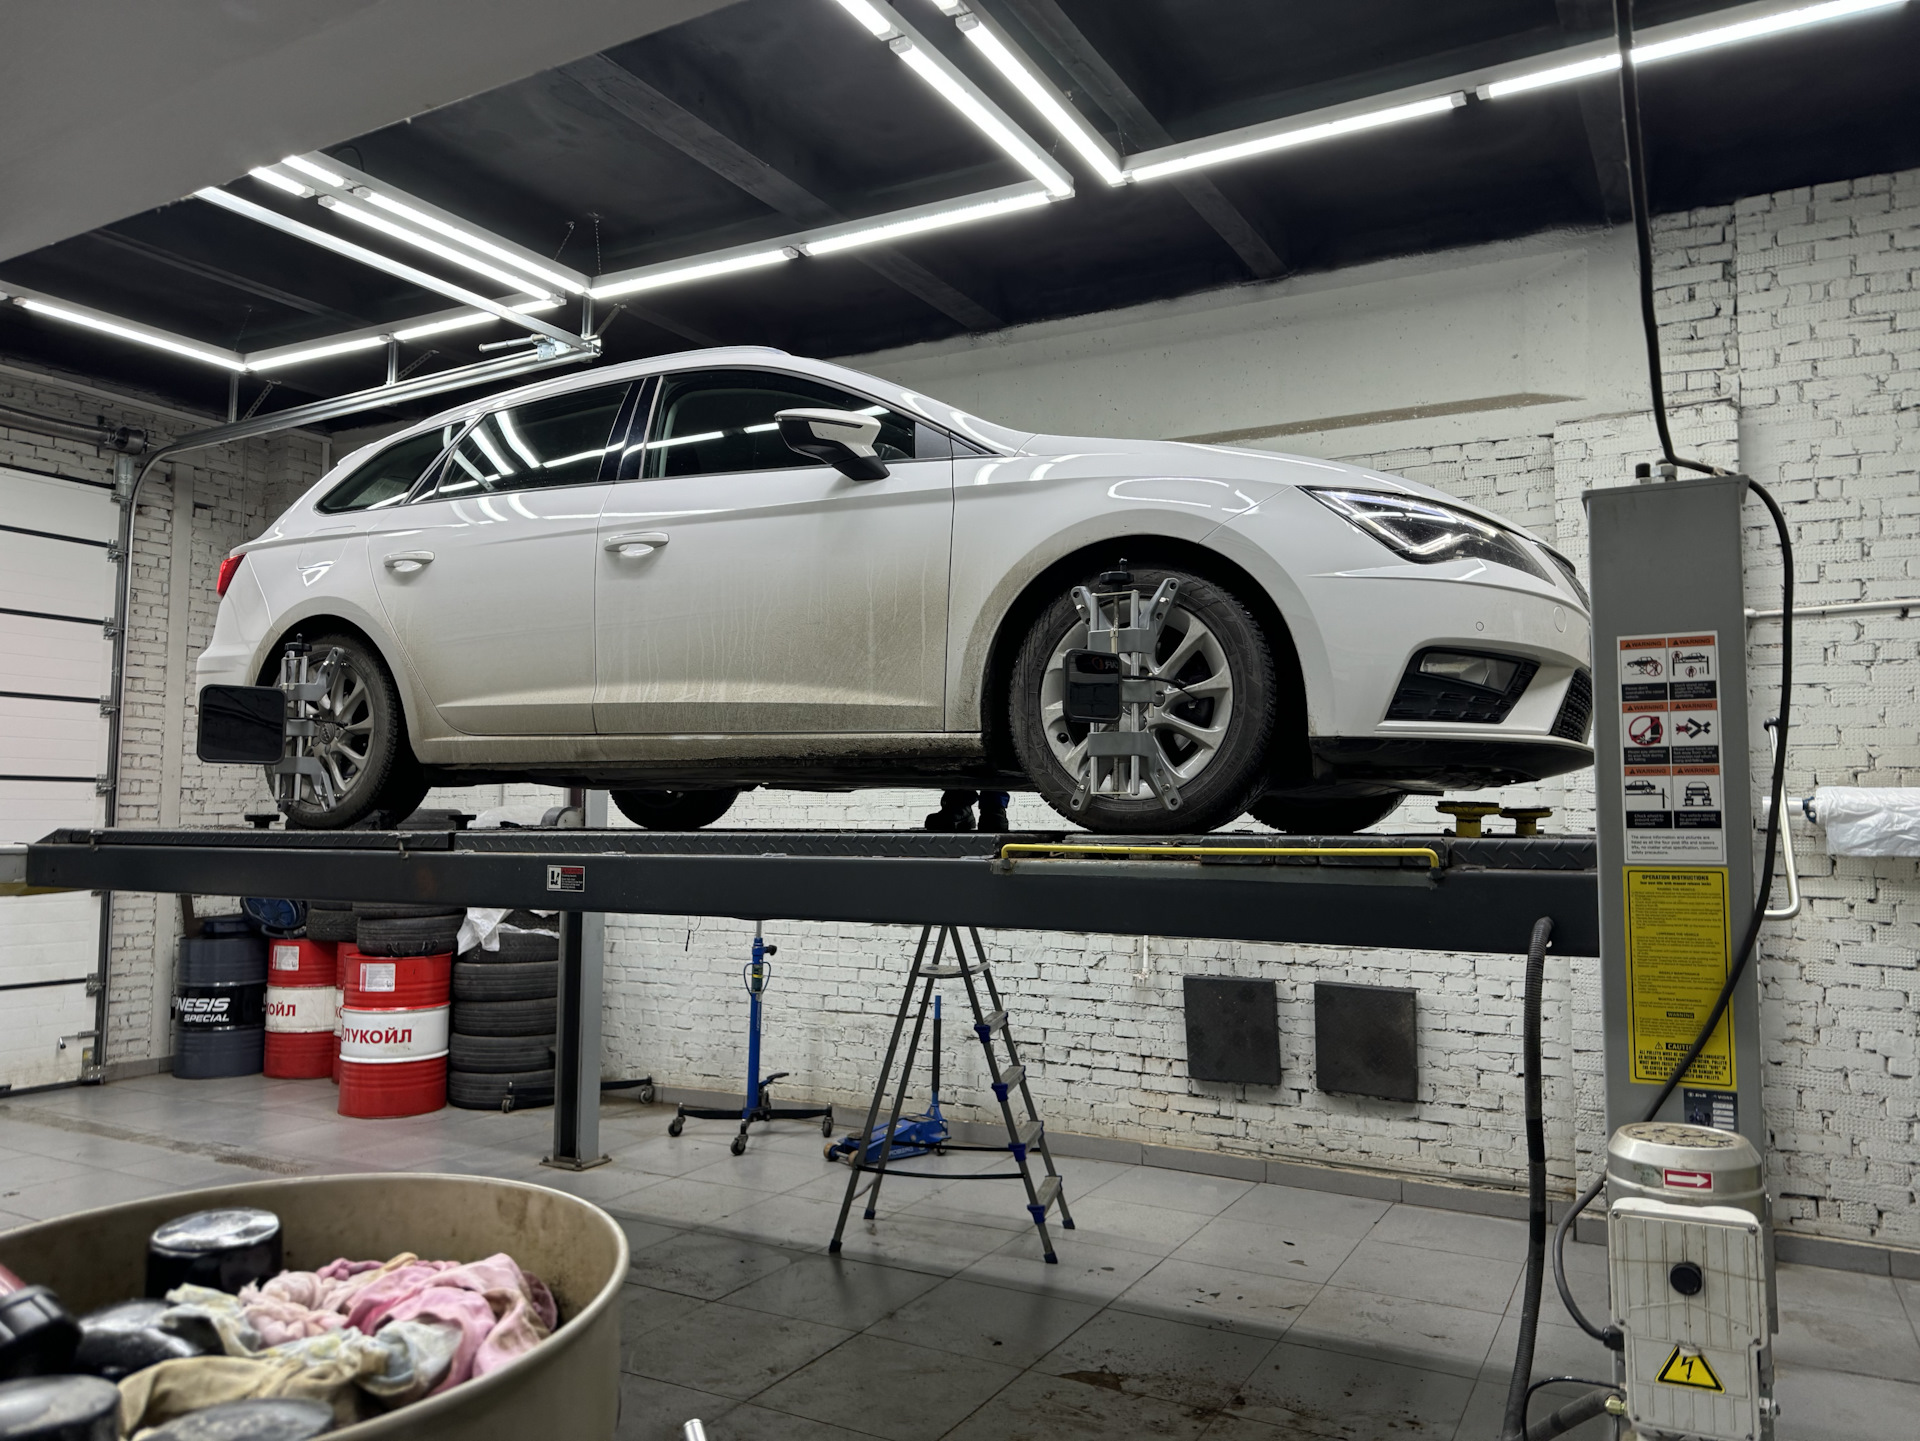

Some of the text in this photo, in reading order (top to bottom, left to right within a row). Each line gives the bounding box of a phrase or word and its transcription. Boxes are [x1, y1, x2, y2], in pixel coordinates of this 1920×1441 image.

[176, 997, 231, 1012] NESIS
[265, 1000, 296, 1017] КОЙЛ
[183, 1013, 230, 1023] SPECIAL
[343, 1026, 412, 1044] ЛУКОЙЛ
